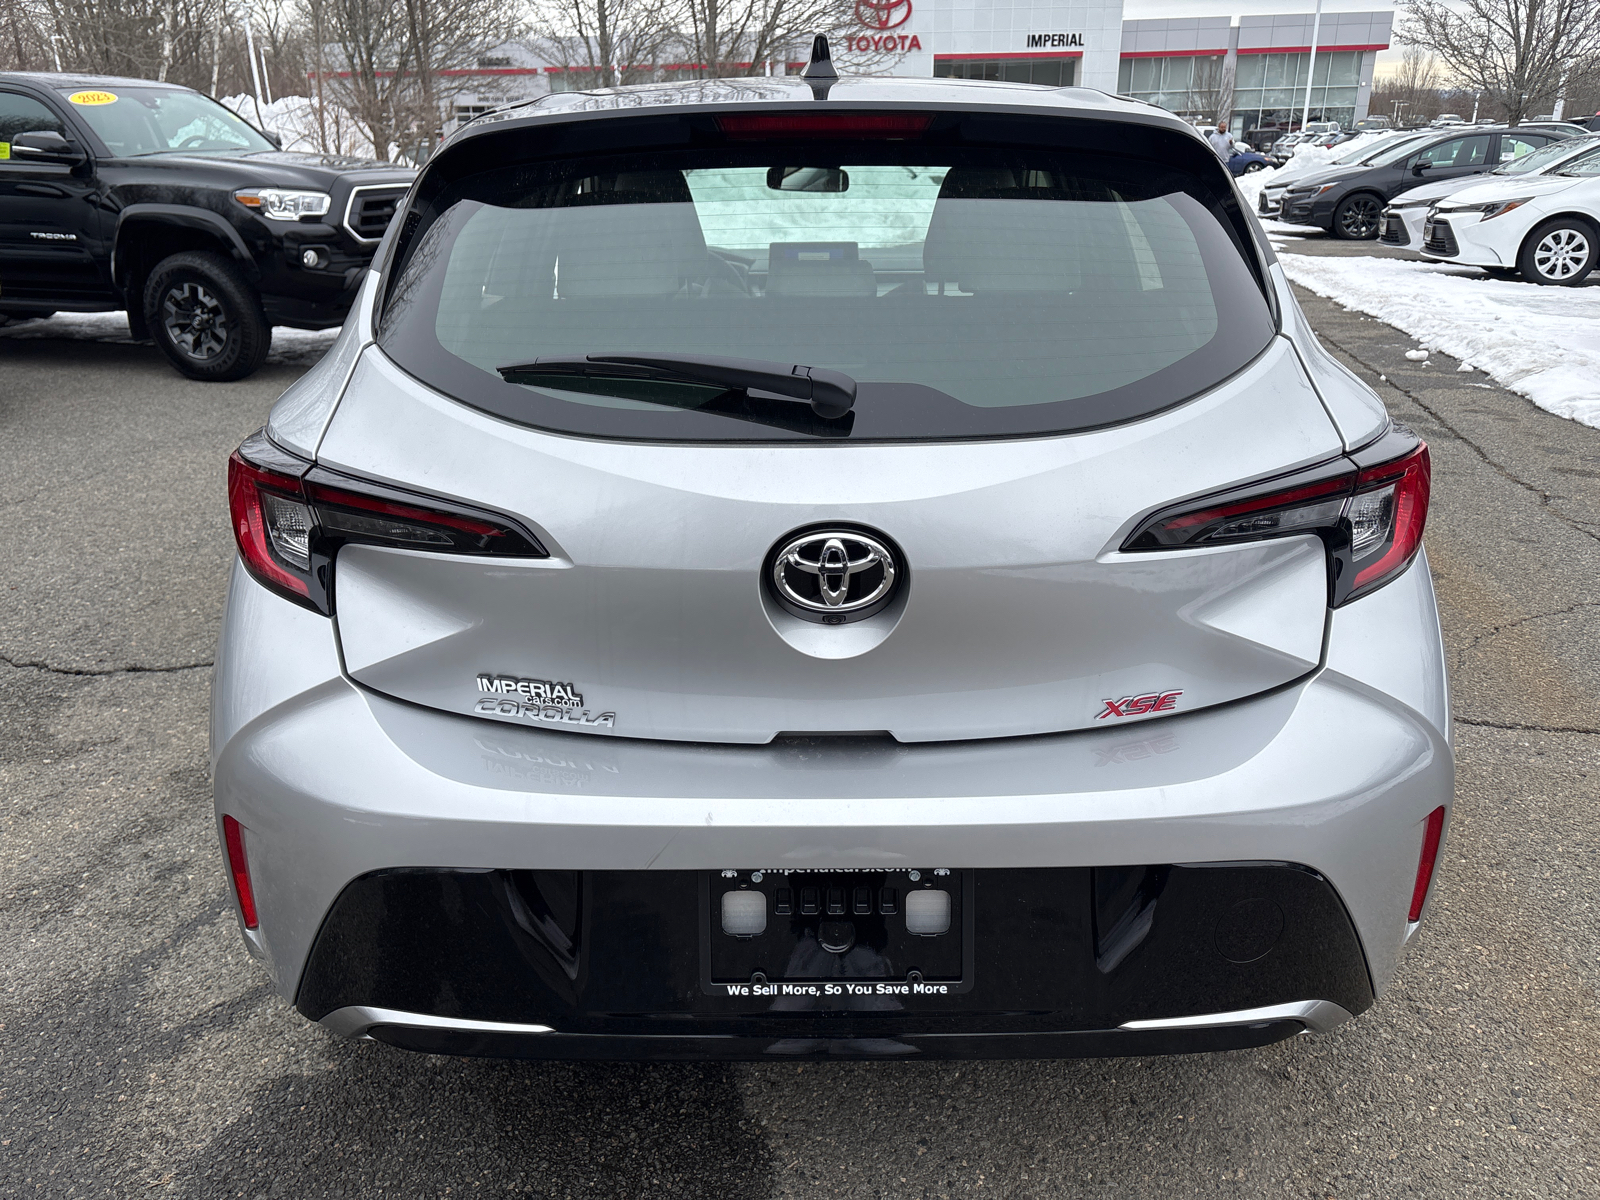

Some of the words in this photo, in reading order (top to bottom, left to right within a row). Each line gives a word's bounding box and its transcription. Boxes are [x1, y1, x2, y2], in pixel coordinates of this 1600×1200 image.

[846, 35, 922, 52] TOYOTA
[1026, 33, 1084, 47] IMPERIAL
[78, 93, 110, 103] 2023
[476, 675, 582, 700] IMPERIAL
[525, 695, 582, 707] cars.com
[1094, 689, 1184, 720] XSE
[474, 697, 616, 728] COROLLA
[727, 986, 749, 995] We
[753, 985, 777, 995] Sell
[783, 985, 820, 996] More,
[825, 985, 842, 994] So
[846, 985, 872, 994] You
[876, 985, 909, 994] Save
[914, 985, 947, 993] More
